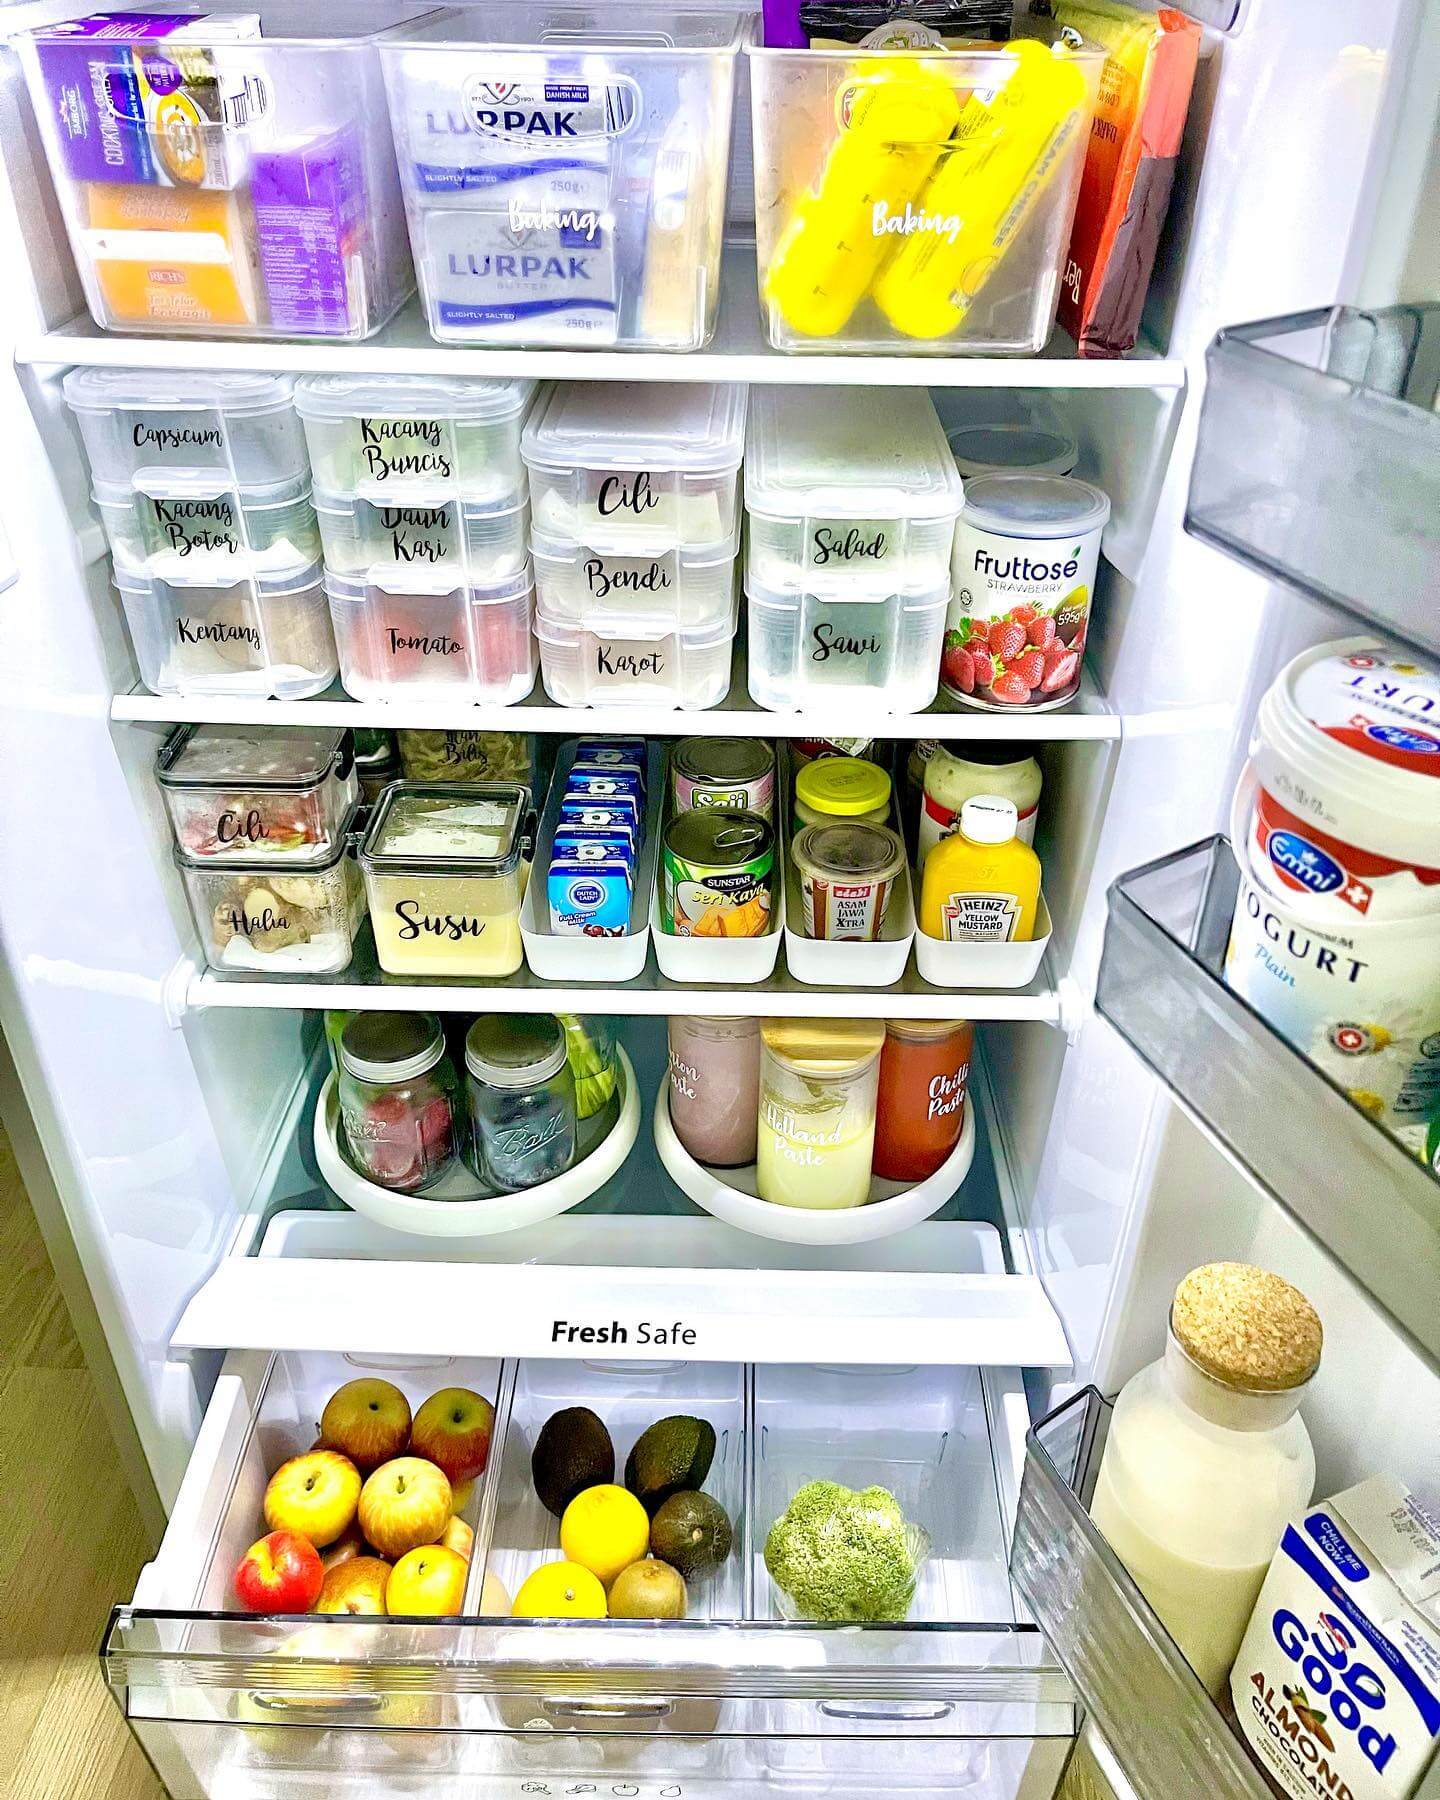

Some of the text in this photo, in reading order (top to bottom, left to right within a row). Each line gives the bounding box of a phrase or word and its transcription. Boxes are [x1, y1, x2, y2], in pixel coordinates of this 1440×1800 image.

[546, 91, 588, 100] DANISH MILK
[425, 174, 463, 183] SLIGHTLY
[992, 110, 1078, 248] CREAM CHEESE
[872, 200, 962, 244] Baking
[448, 253, 592, 280] LURPAK
[446, 311, 514, 320] SLIGHTLY SALTED
[133, 423, 222, 451] Capsicum
[360, 417, 442, 445] Kacang
[362, 444, 451, 481] Buncis
[597, 471, 659, 516] Cili
[154, 499, 234, 526] Kacang
[164, 522, 239, 557] Botor
[392, 529, 447, 563] Kari
[812, 528, 887, 565] Salad
[583, 558, 671, 598] Bendi
[973, 549, 1078, 582] Fruttose
[986, 578, 1062, 594] STRAWBERRY
[176, 617, 261, 650] Kentang
[1057, 611, 1080, 626] 595g
[385, 627, 464, 655] Tomato
[811, 623, 881, 662] Sawi
[596, 646, 664, 676] Karot
[216, 809, 270, 844] Cili
[691, 882, 765, 906] Seri Kaya
[707, 875, 751, 887] SUNSTAR
[559, 911, 596, 922] Full Cream
[837, 900, 867, 909] ASAM
[838, 909, 864, 918] JAWA
[963, 901, 1003, 912] HEINZ
[965, 914, 999, 922] YELLOW
[229, 907, 292, 937] Halia
[394, 899, 486, 941] Susu
[836, 918, 865, 928] XTRA
[958, 920, 1003, 931] MUSTARD
[1254, 942, 1296, 988] Plain
[928, 1062, 968, 1099] Chilli
[767, 1103, 842, 1144] Holland
[775, 1136, 825, 1167] Paste
[551, 1320, 697, 1345] Fresh Safe
[1319, 1534, 1346, 1565] NOW!
[1320, 1521, 1362, 1571] CHILL ME
